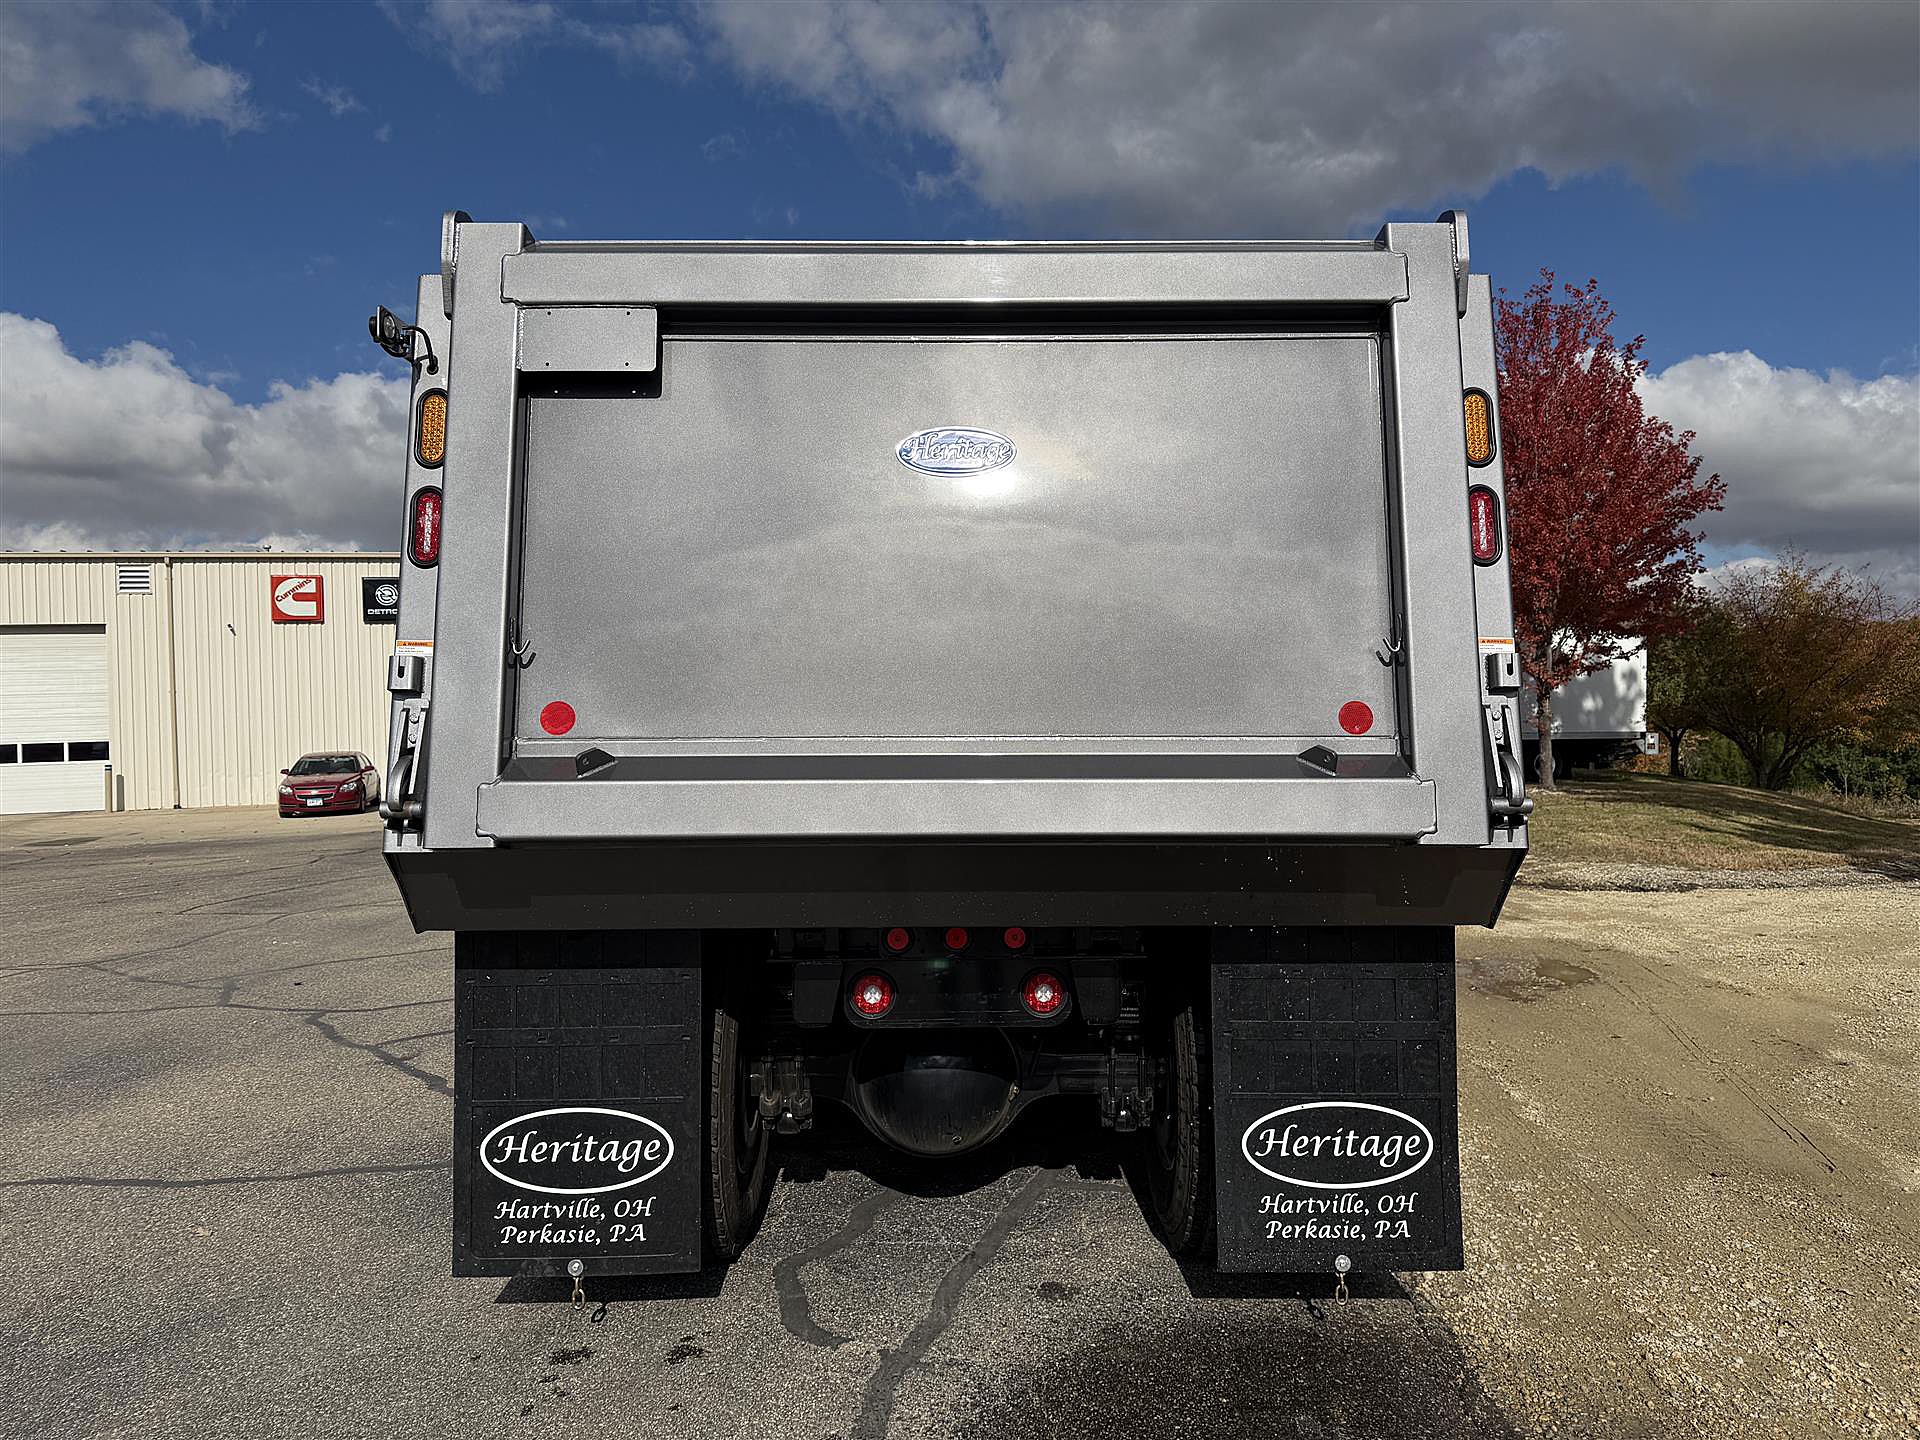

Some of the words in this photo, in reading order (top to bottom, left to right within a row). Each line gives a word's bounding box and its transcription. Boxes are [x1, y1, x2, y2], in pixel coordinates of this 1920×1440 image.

[901, 432, 1012, 466] Heritage
[275, 579, 312, 602] Cummins
[493, 1131, 661, 1173] Heritage
[1255, 1124, 1421, 1168] Heritage
[494, 1198, 606, 1221] Hartville,
[614, 1196, 657, 1218] OH
[1258, 1193, 1370, 1216] Hartville,
[1377, 1192, 1419, 1214] OH
[500, 1223, 601, 1246] Perkasie,
[609, 1223, 647, 1242] PA
[1265, 1218, 1366, 1241] Perkasie,
[1374, 1220, 1411, 1239] PA
